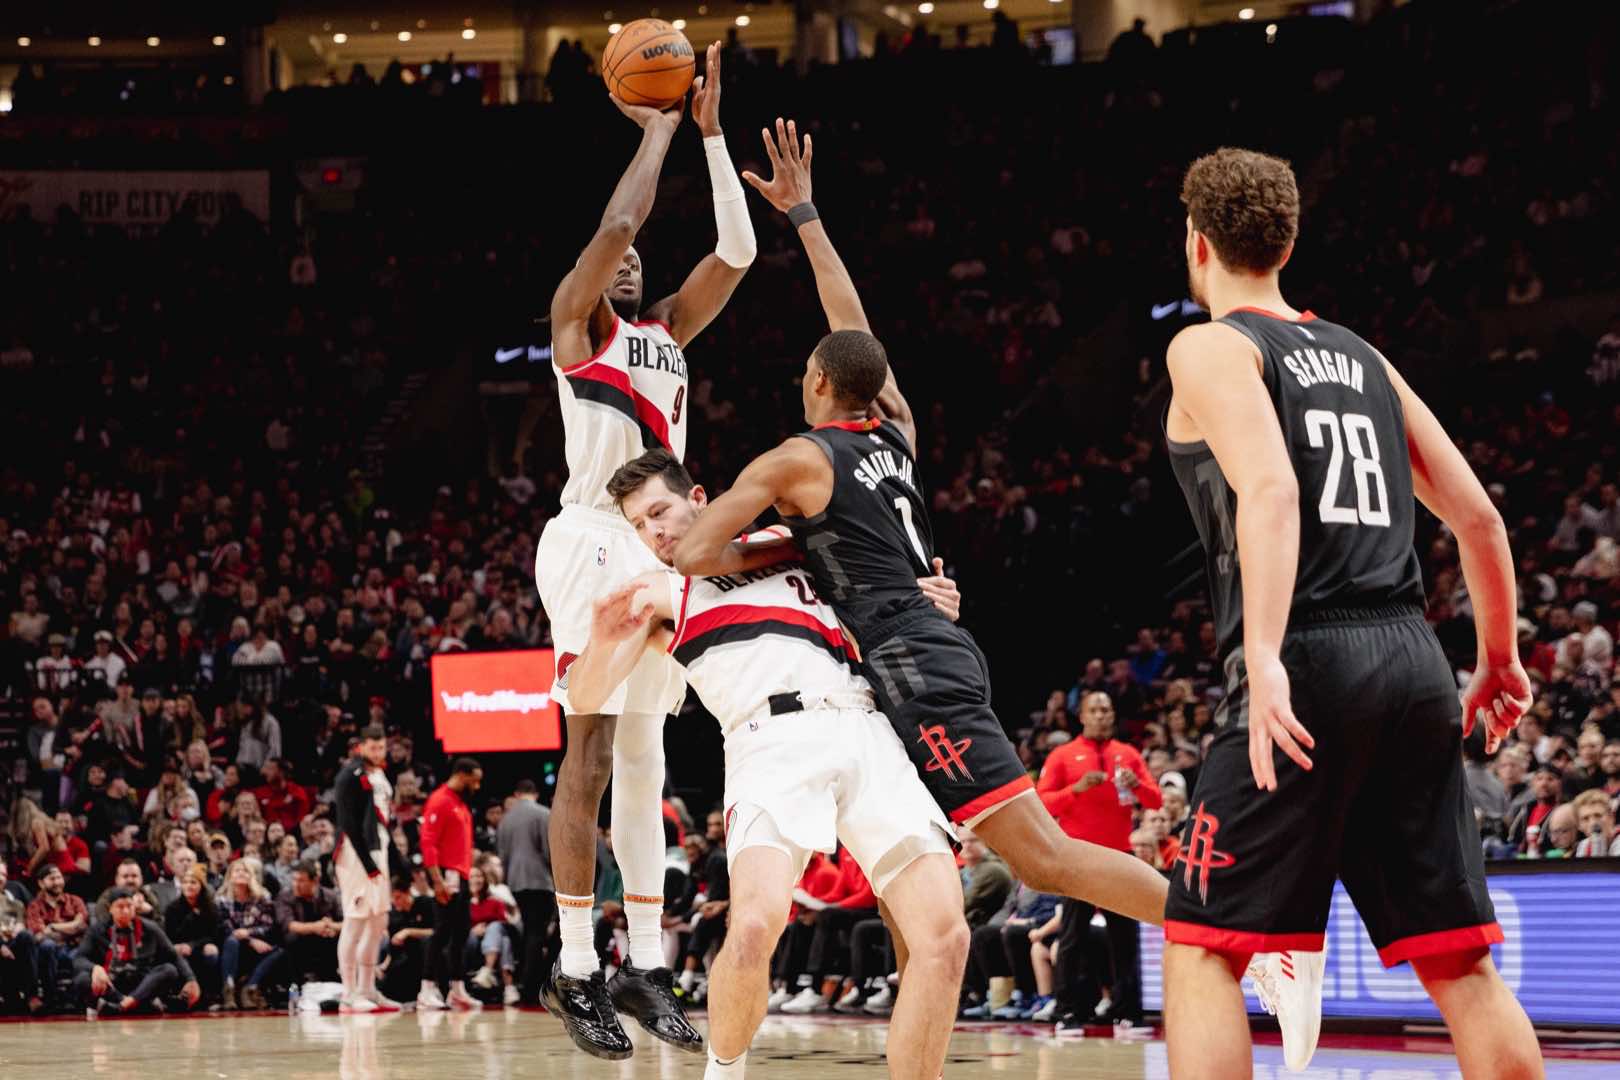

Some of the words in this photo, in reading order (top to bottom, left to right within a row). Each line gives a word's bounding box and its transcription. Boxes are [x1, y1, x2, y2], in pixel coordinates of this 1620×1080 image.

[79, 191, 119, 218] RIP
[1283, 348, 1364, 395] SENGUN
[671, 385, 685, 425] 9
[853, 450, 899, 491] SMITH
[1304, 409, 1391, 528] 28
[893, 496, 932, 574] 1
